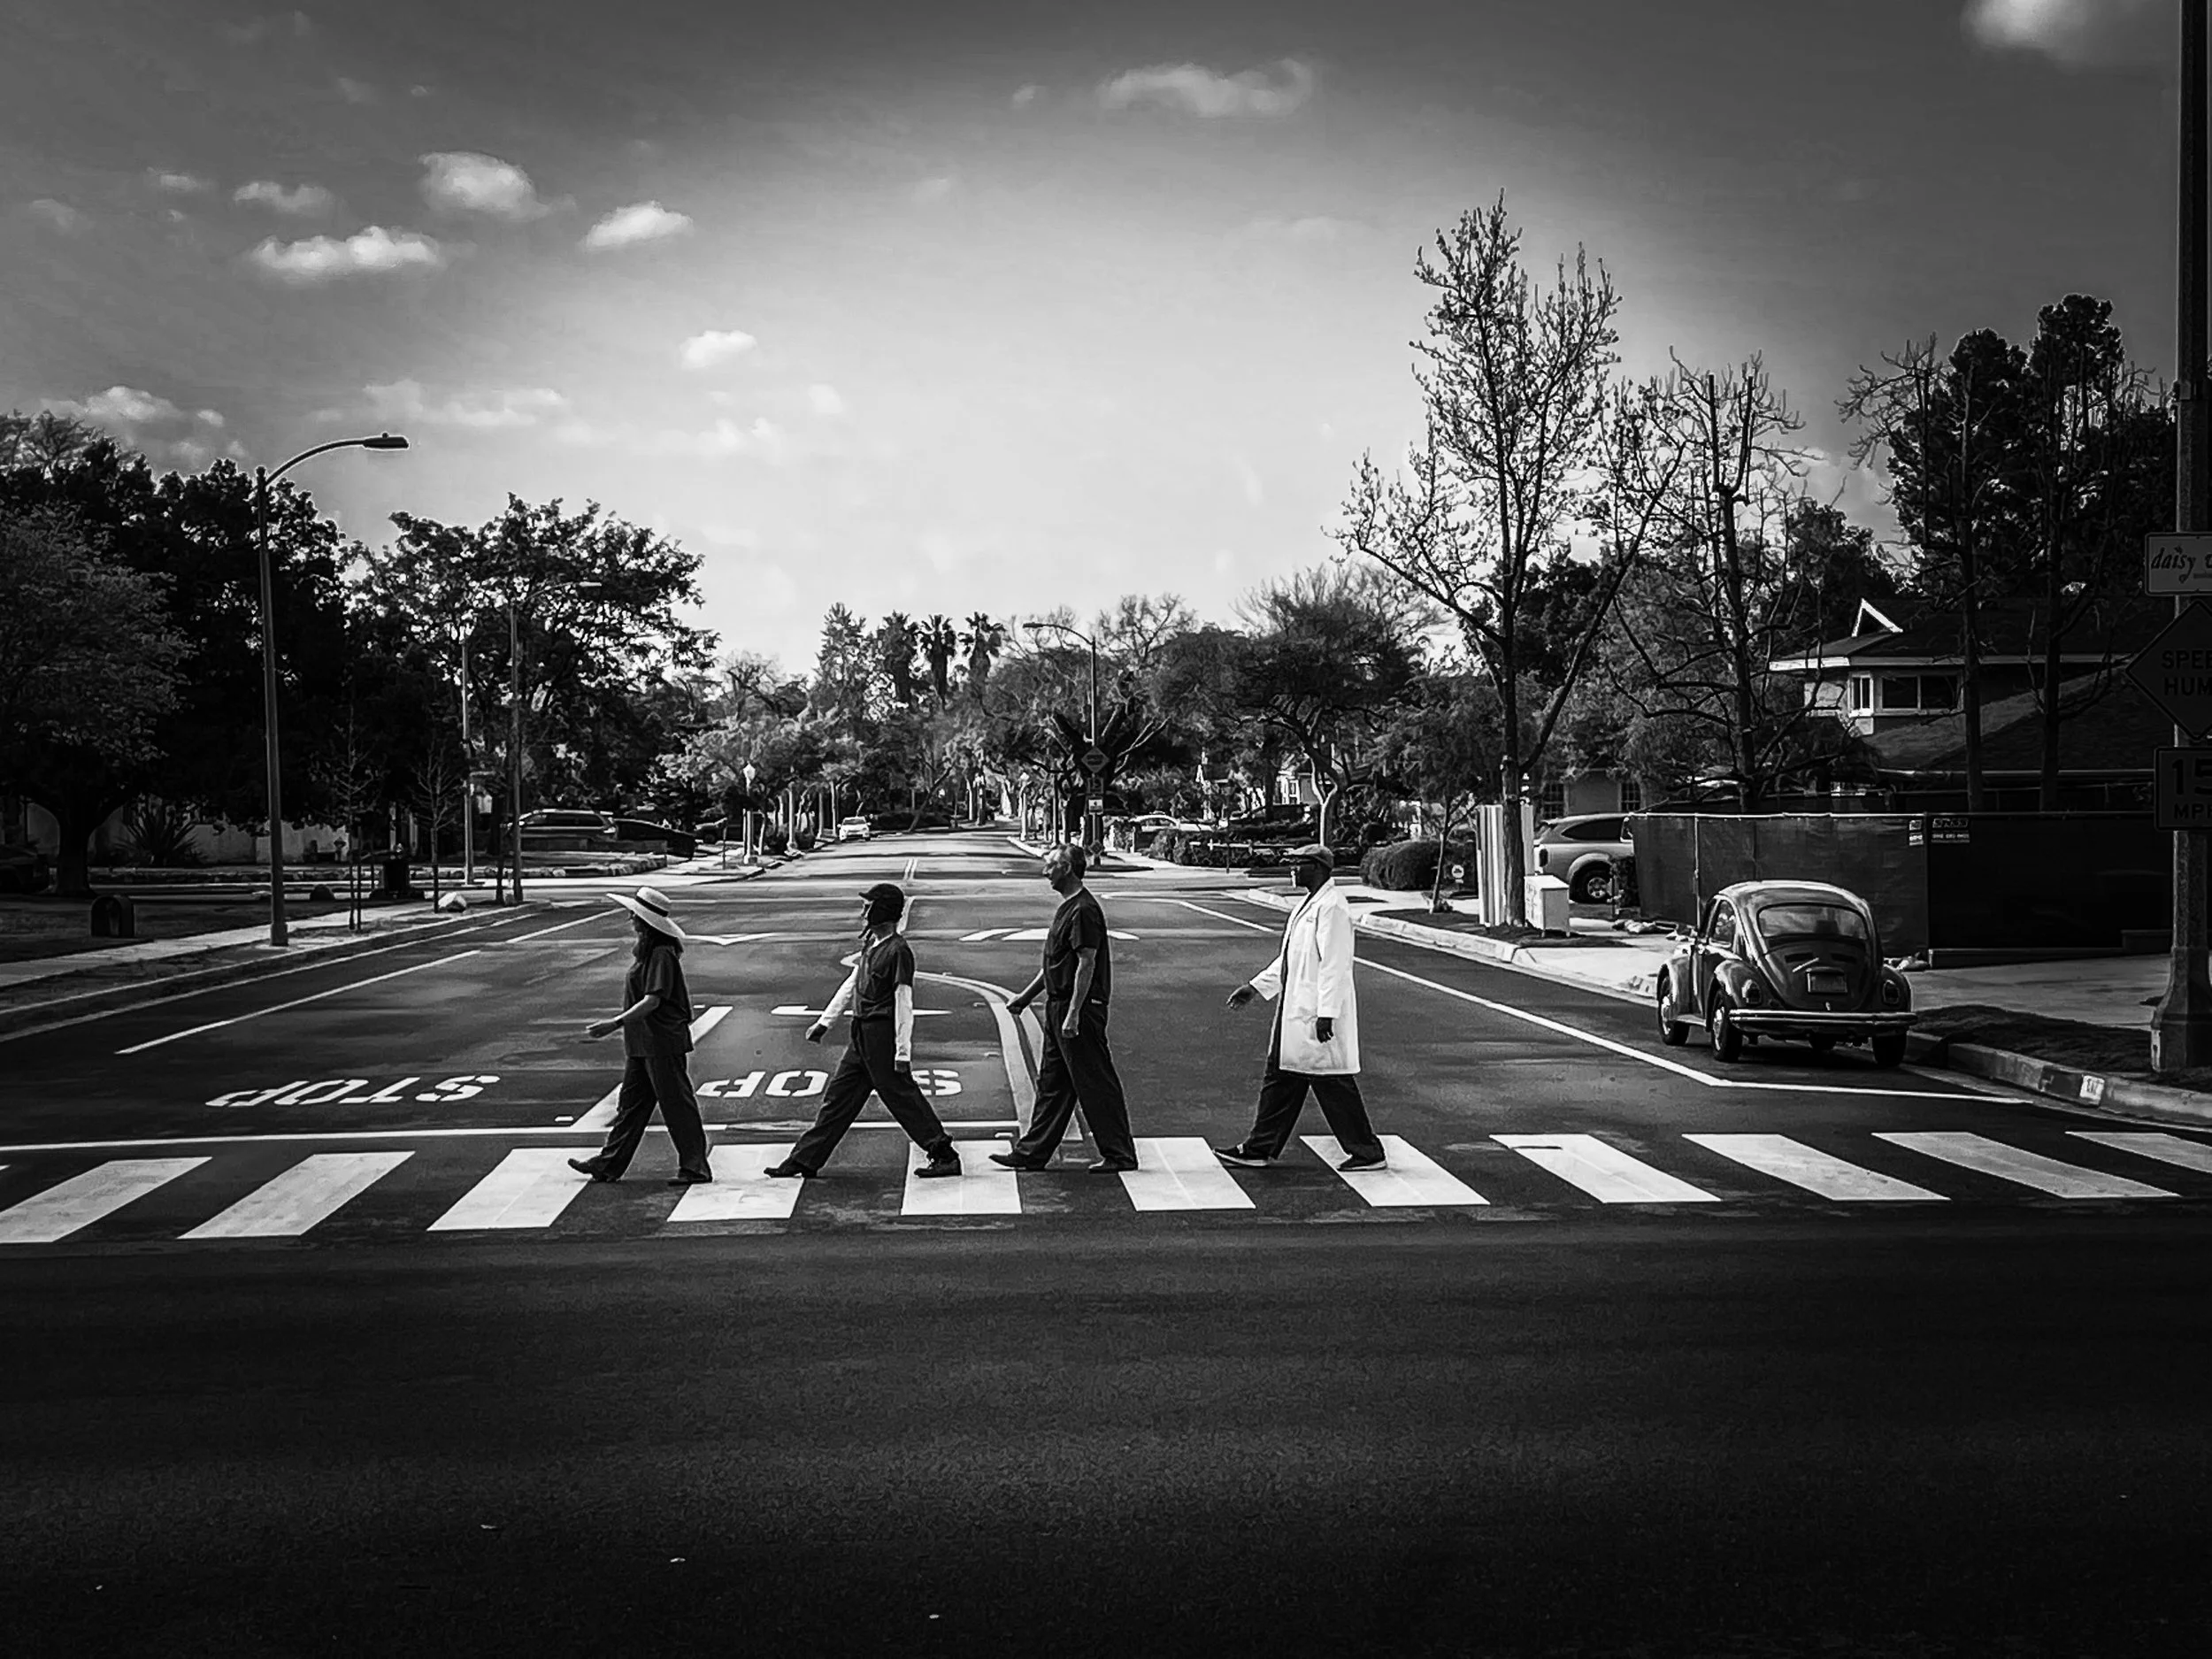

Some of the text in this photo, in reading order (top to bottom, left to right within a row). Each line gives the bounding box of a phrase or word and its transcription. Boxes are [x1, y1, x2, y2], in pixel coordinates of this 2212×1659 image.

[2152, 546, 2196, 584] daisy
[205, 1075, 500, 1106] STOP
[695, 1070, 962, 1097] SOP
